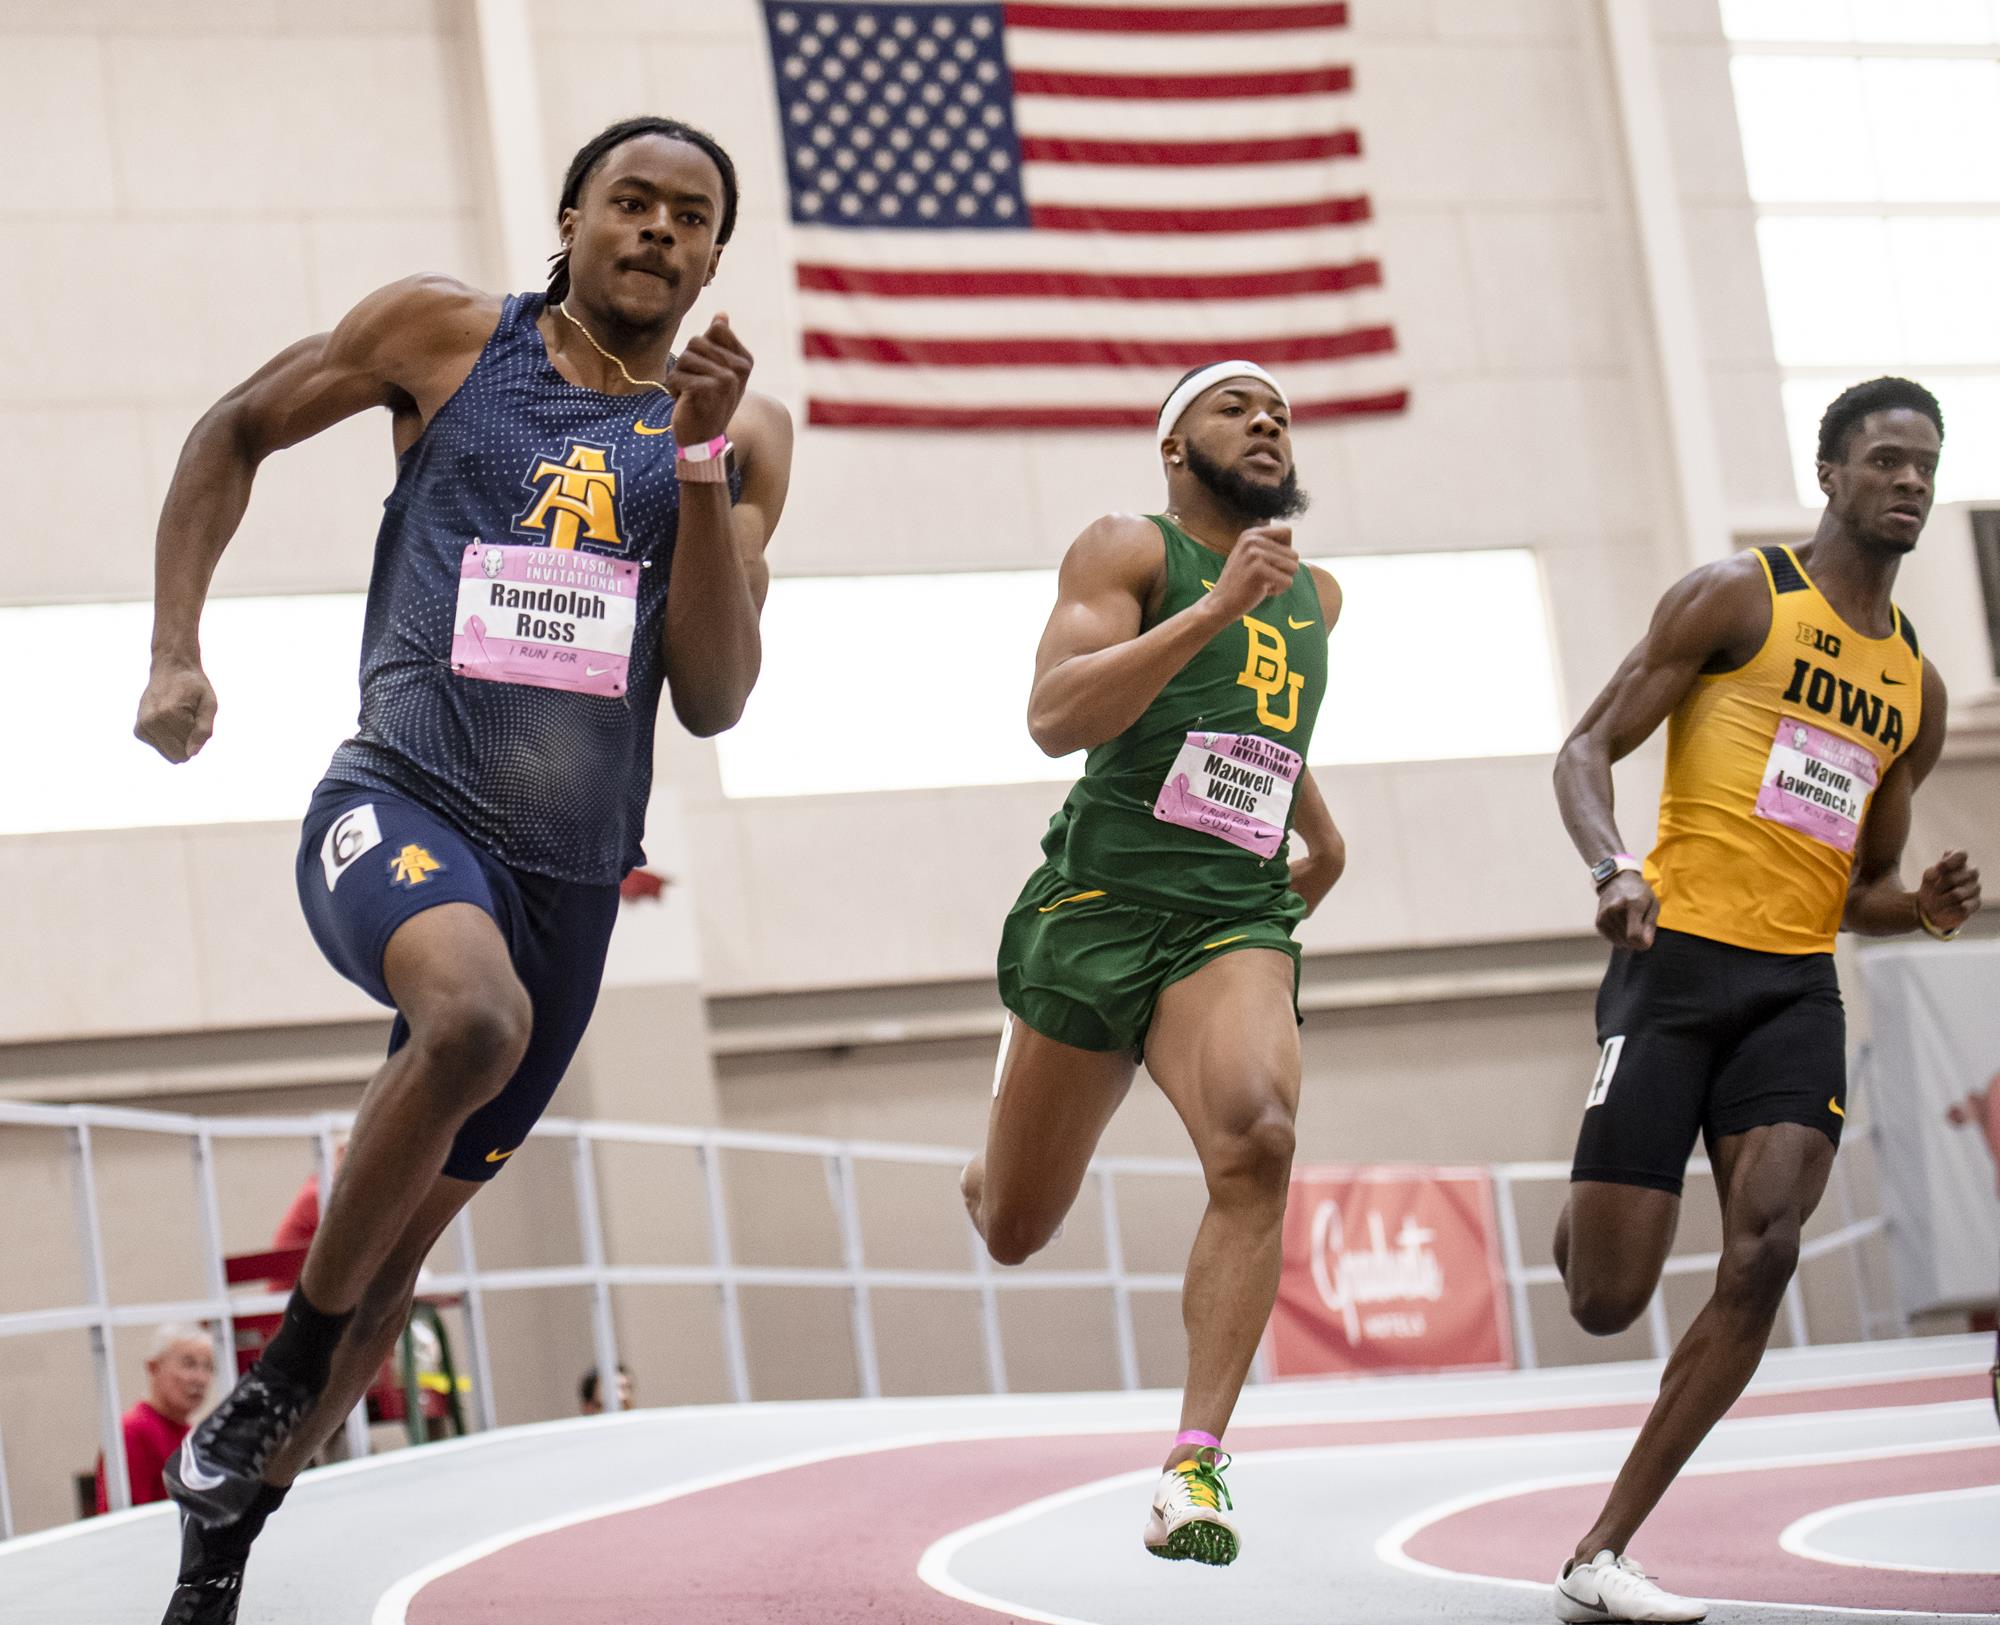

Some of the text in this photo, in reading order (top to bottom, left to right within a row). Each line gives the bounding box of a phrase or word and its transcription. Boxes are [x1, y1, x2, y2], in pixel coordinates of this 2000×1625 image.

[526, 567, 622, 593] INVITATIONAL
[527, 552, 615, 576] 2020 TYSON
[490, 583, 605, 619] Randolph
[516, 613, 575, 643] Ross
[520, 646, 548, 660] RUN
[553, 649, 577, 663] FOR
[1782, 658, 1903, 755] IOWA
[1230, 745, 1292, 778] INVITATIONAL
[1235, 736, 1292, 764] 2020 TYSON
[1203, 754, 1274, 796] Maxwell
[1776, 770, 1847, 814] Lawrence
[1804, 758, 1852, 793] Wayne
[1207, 778, 1258, 813] Willis
[333, 813, 364, 868] 6
